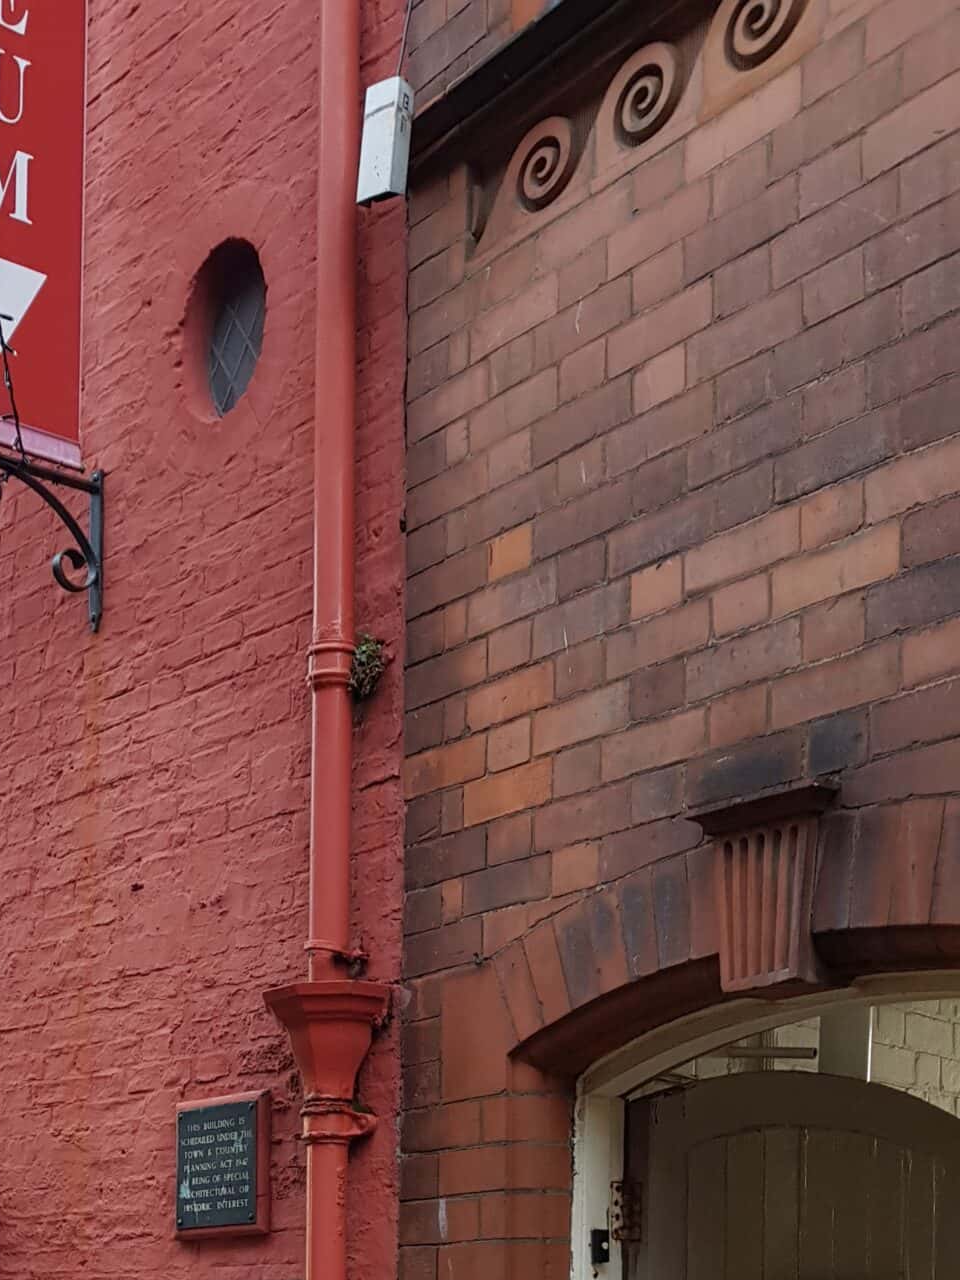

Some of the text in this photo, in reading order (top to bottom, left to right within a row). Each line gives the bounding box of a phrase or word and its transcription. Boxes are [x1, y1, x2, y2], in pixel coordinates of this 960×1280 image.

[203, 1119, 235, 1130] BUILDING
[181, 1135, 215, 1146] SCHEDULED
[217, 1131, 238, 1142] UNDER
[184, 1150, 204, 1159] TOWN
[216, 1143, 248, 1155] COUNTRY
[183, 1162, 217, 1173] PLANNING
[220, 1159, 232, 1168] ACT
[192, 1175, 210, 1185] BEING
[212, 1174, 221, 1184] OF
[223, 1171, 249, 1182] SPECIAL
[184, 1199, 249, 1212] HISTORIC INTEREST
